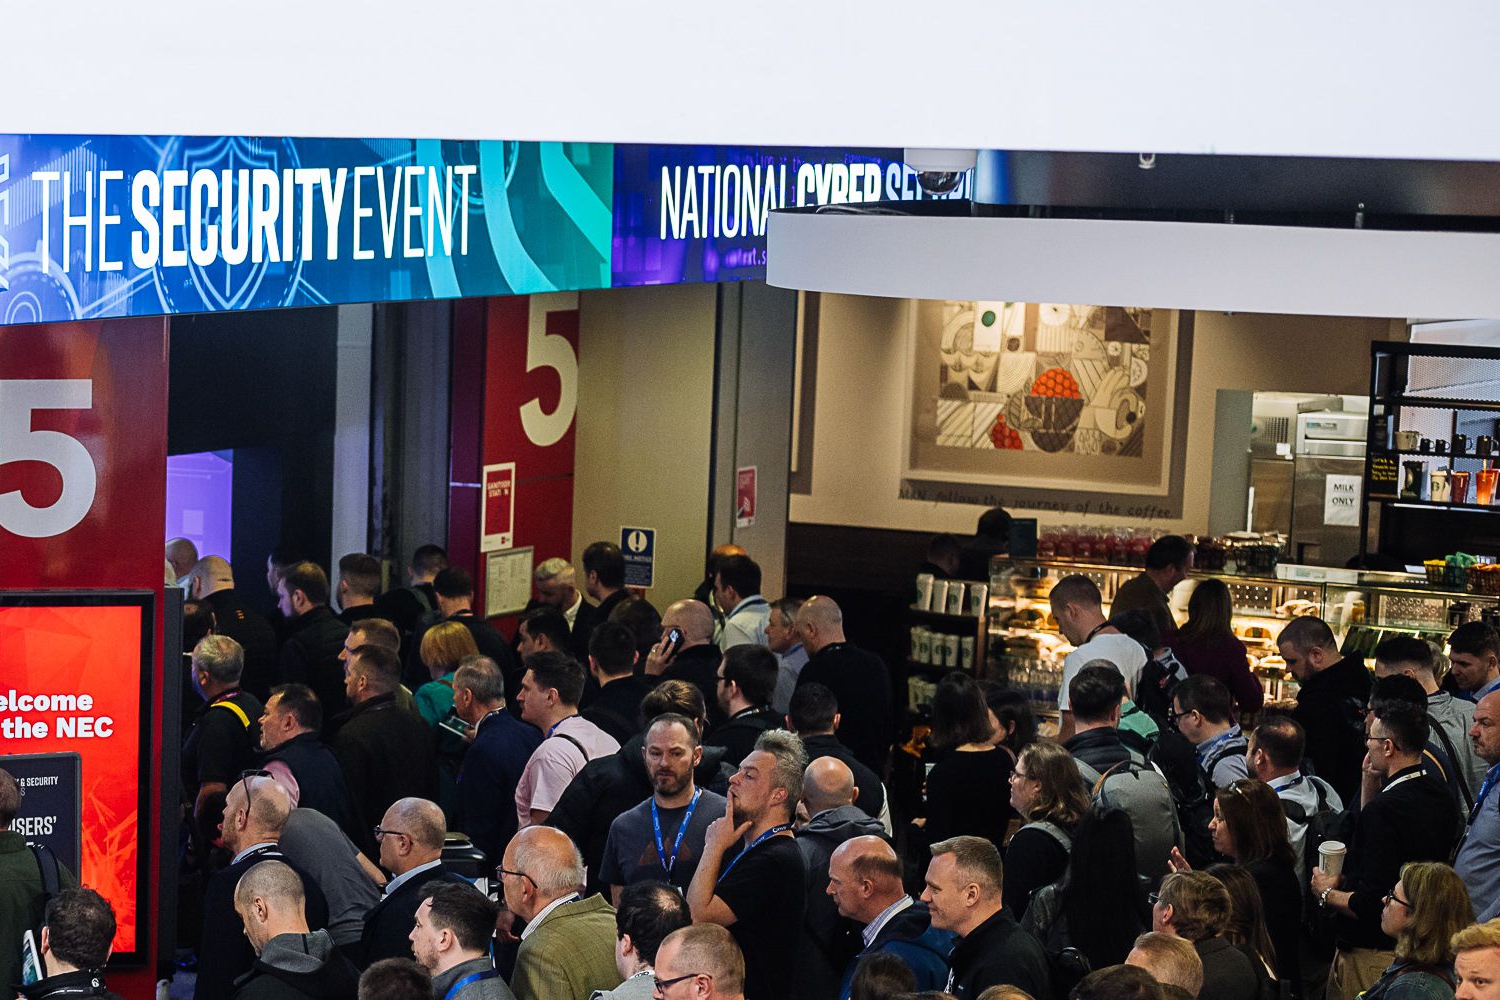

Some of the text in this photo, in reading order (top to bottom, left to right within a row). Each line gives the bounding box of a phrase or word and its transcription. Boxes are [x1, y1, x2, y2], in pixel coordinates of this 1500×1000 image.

[32, 163, 477, 275] THE SECURITY EVENT
[519, 293, 579, 447] 5
[1333, 483, 1355, 492] MILK
[1100, 500, 1121, 515] the
[1332, 497, 1355, 506] ONLY
[1, 716, 48, 740] the
[56, 717, 113, 738] NEC
[20, 776, 59, 787] & SECURITY
